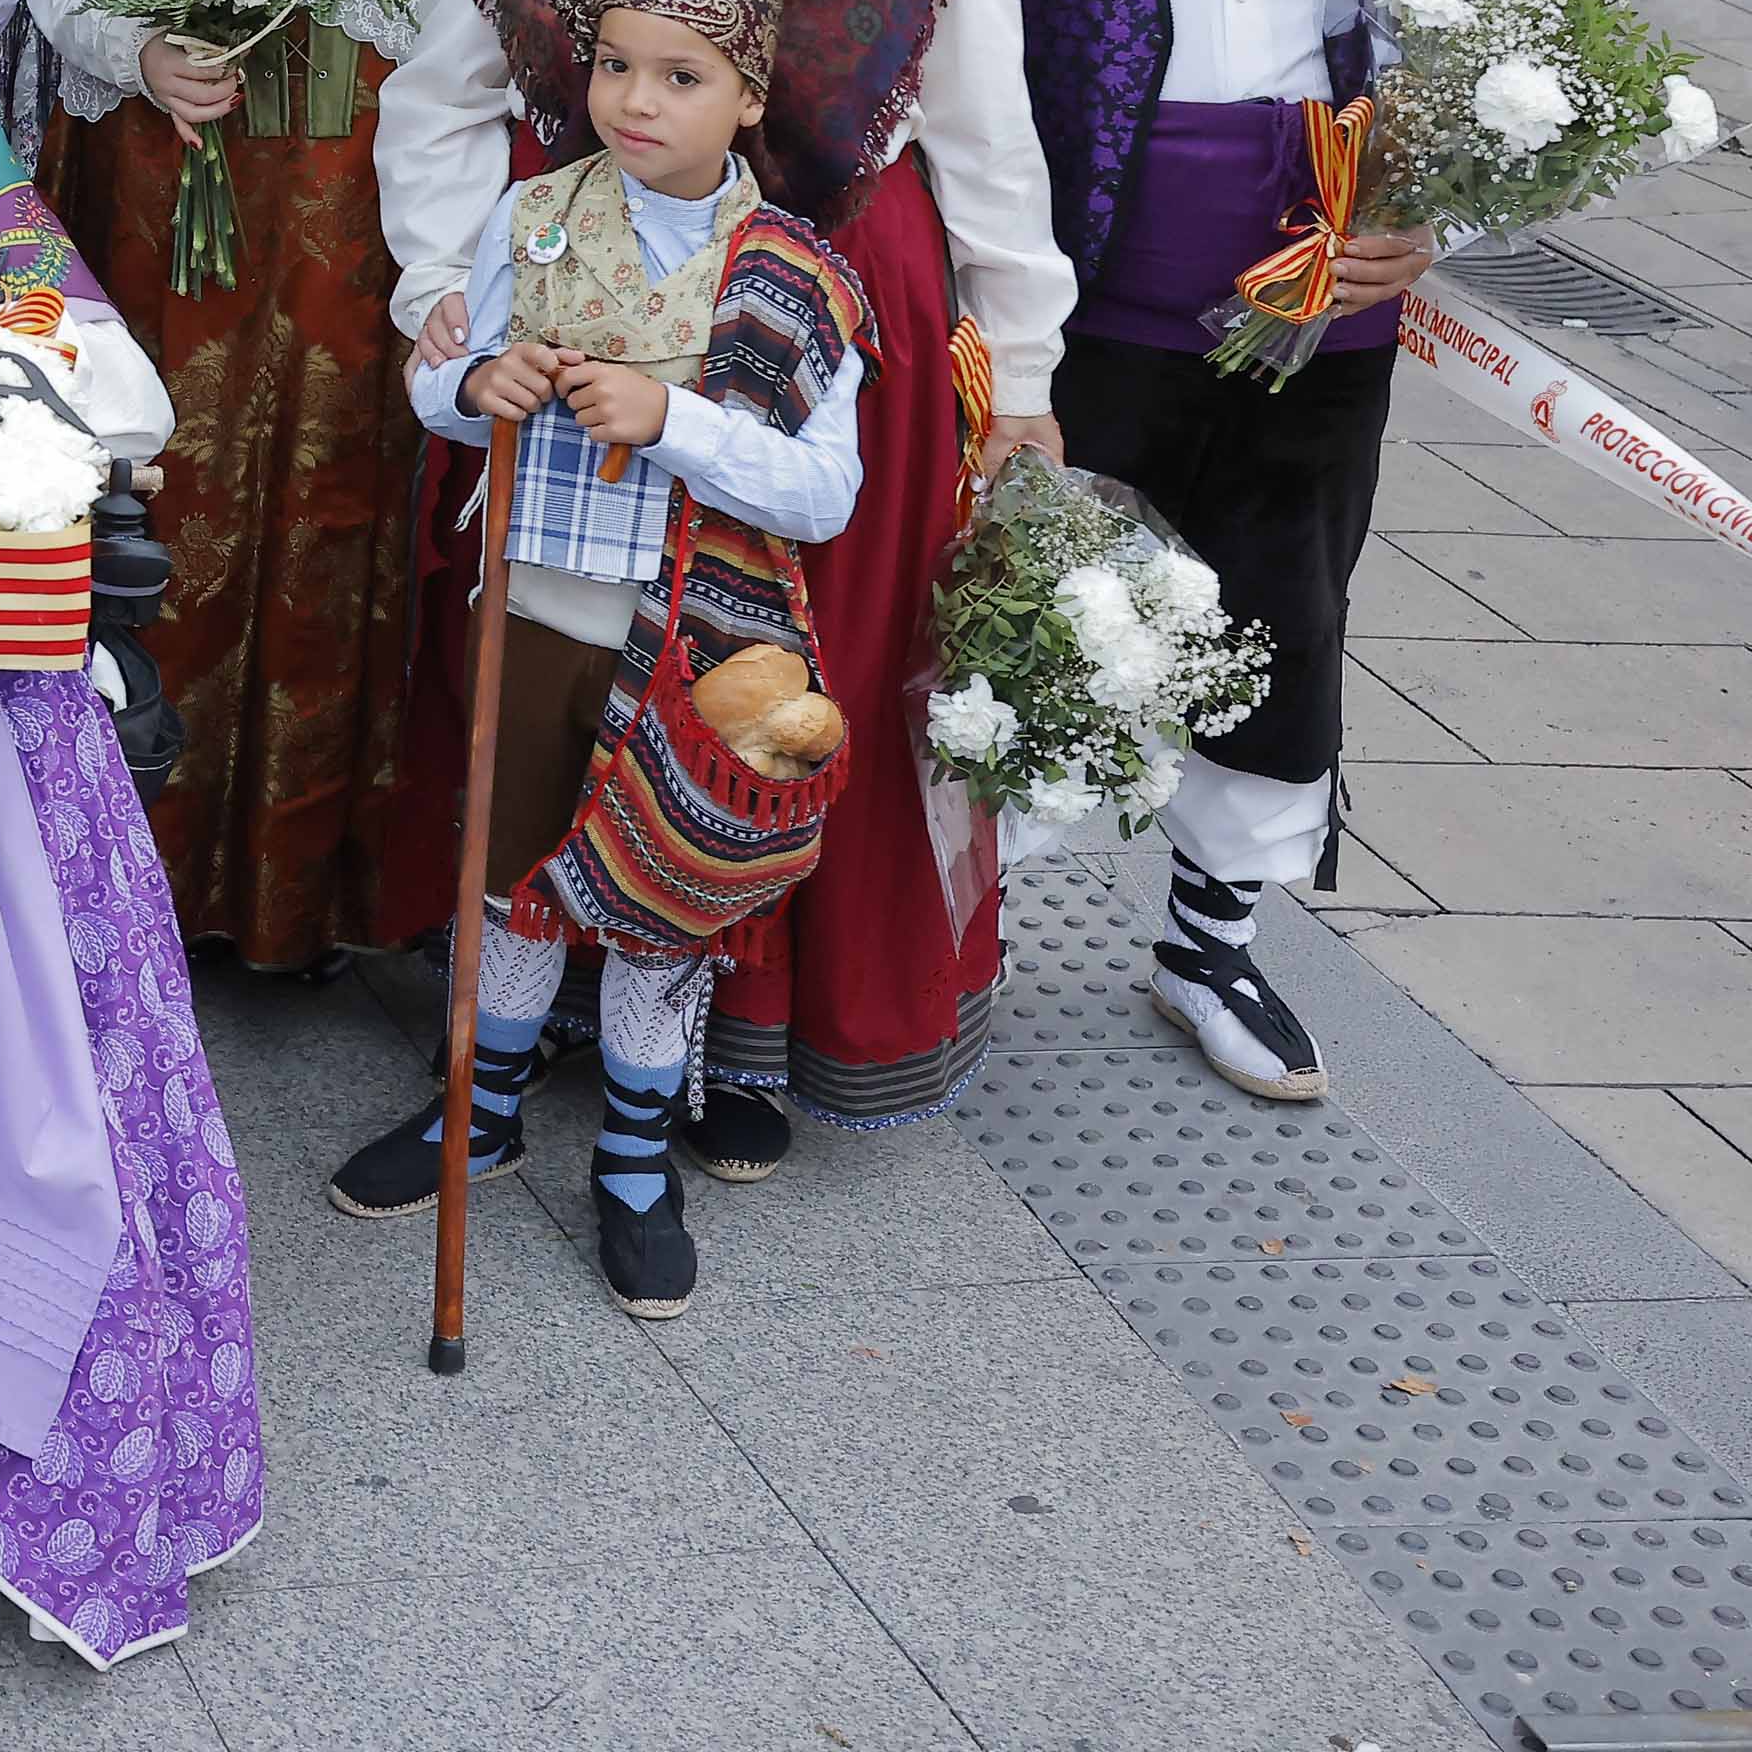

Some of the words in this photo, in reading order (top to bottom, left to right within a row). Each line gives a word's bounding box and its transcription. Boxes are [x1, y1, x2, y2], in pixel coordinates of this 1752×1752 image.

[1397, 320, 1439, 369] GOZA
[1428, 309, 1519, 386] MUNICIPAL
[1707, 496, 1752, 543] CIVI
